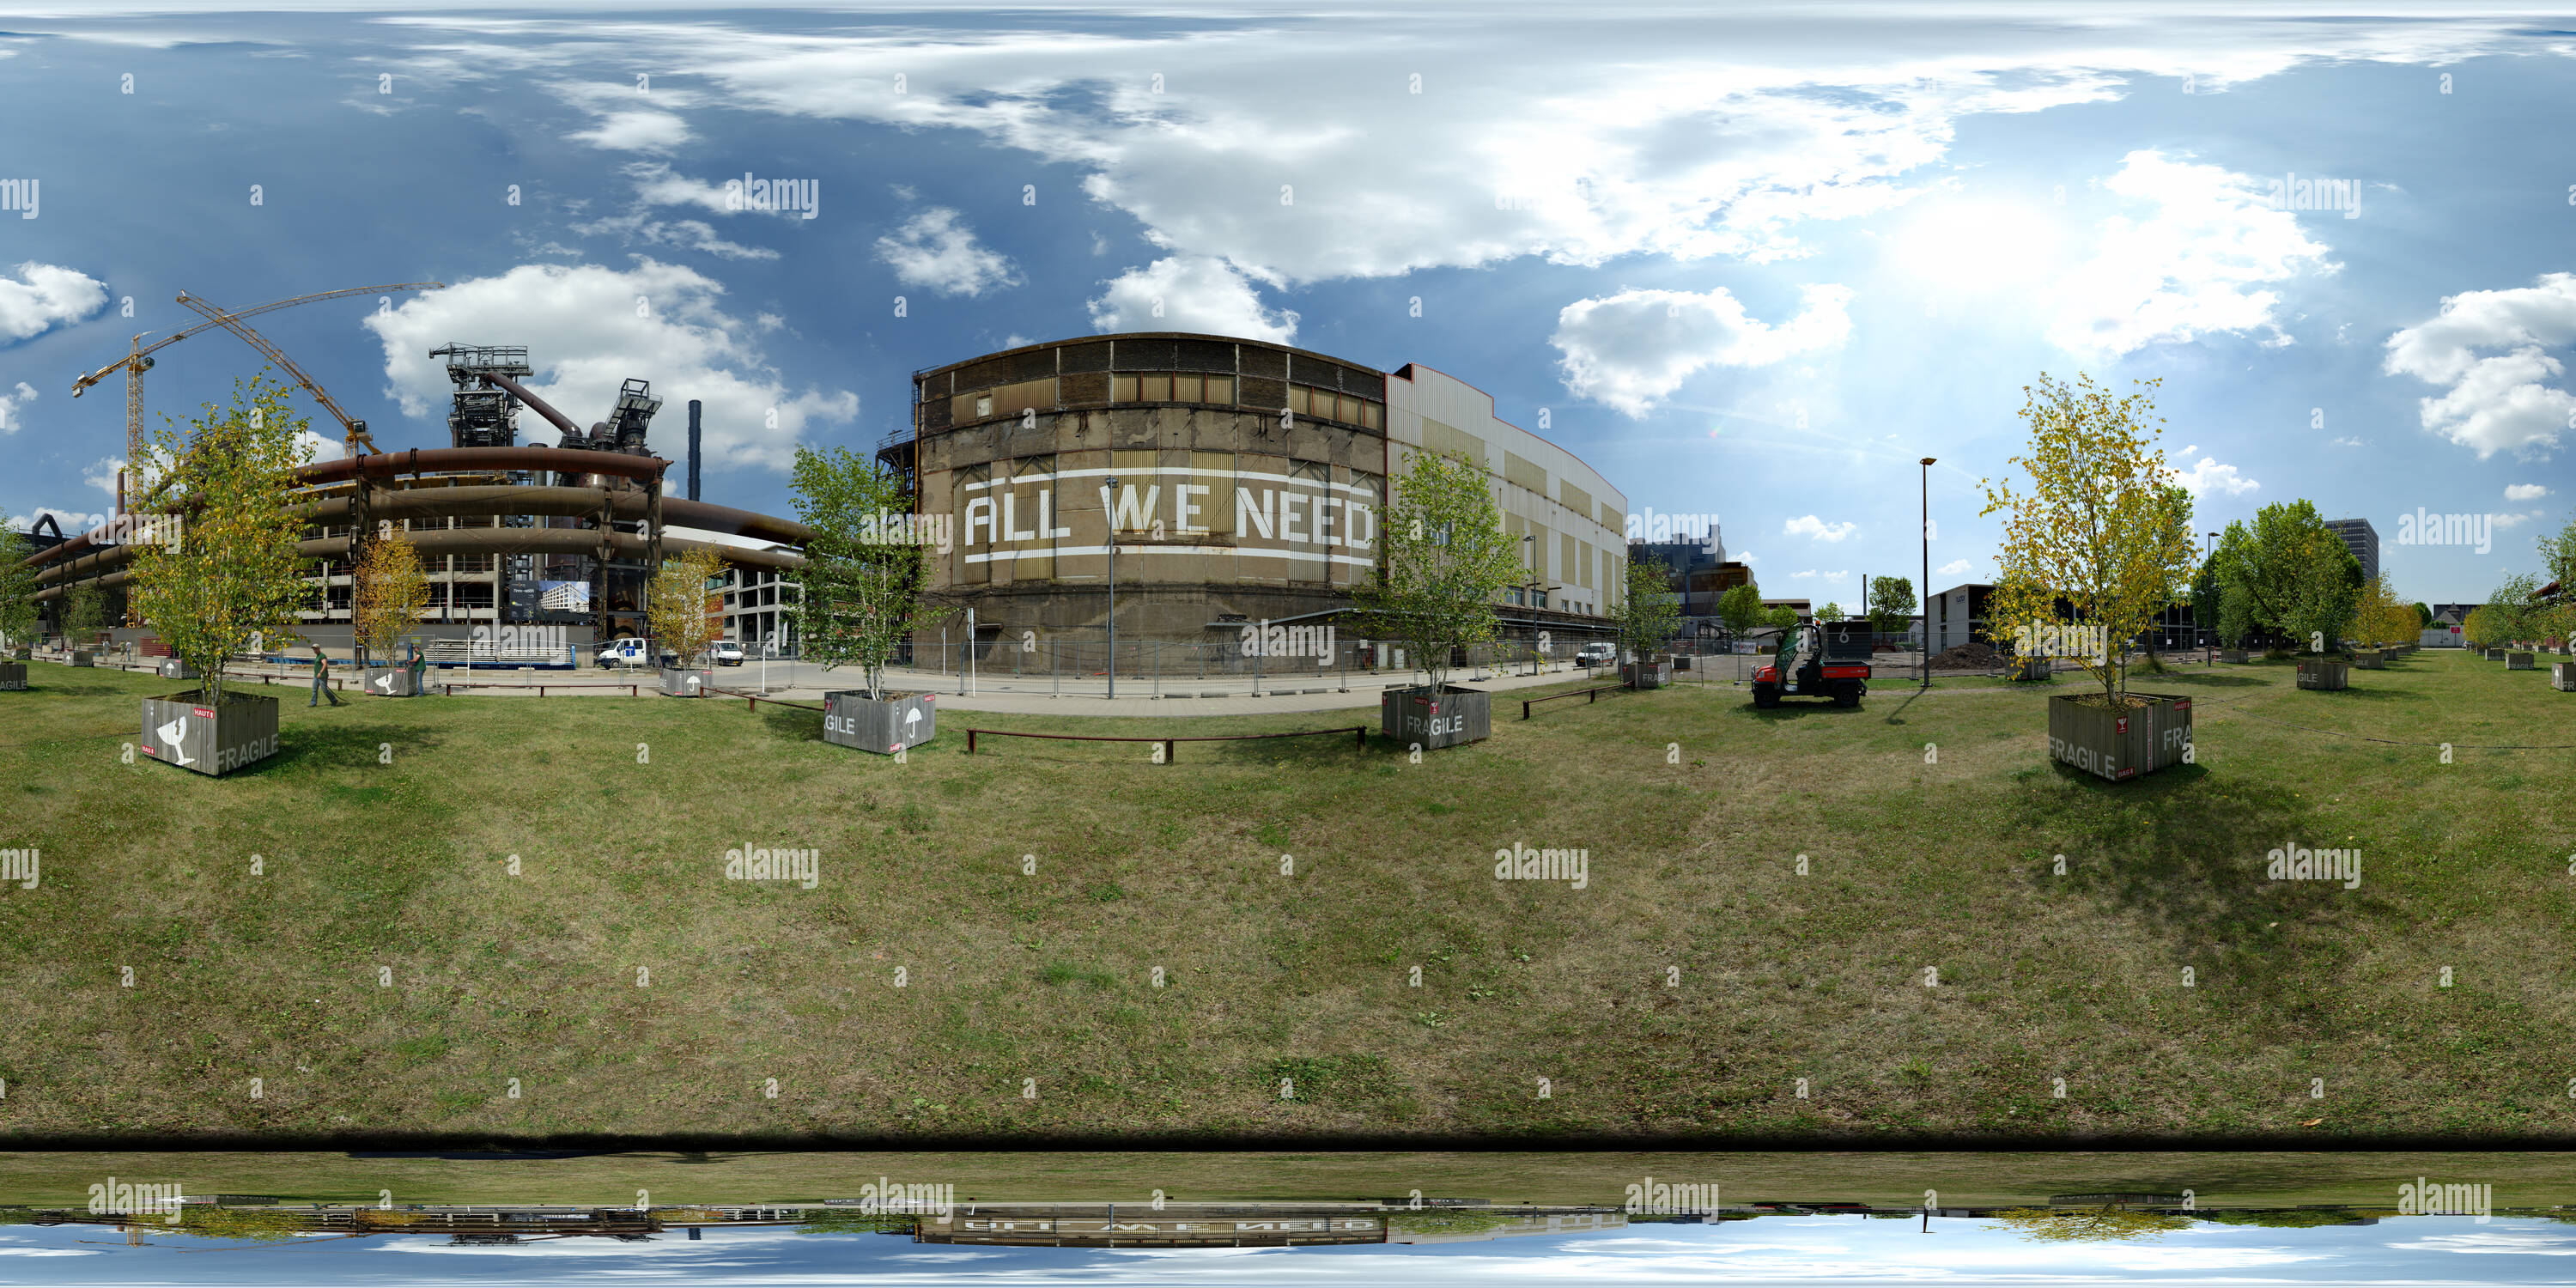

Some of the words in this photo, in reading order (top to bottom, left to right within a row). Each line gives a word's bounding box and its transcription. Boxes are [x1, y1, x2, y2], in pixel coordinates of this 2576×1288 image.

[965, 489, 1071, 546] ALL
[1100, 484, 1210, 536] WE
[1236, 486, 1374, 550] NEED
[1839, 627, 1850, 643] 6
[2298, 673, 2318, 683] GILE
[194, 708, 210, 718] HAUT
[824, 714, 855, 735] GILE
[1407, 714, 1463, 737] FRAGILE
[216, 734, 278, 771] FRAGILE
[2049, 736, 2115, 781] FRAGILE
